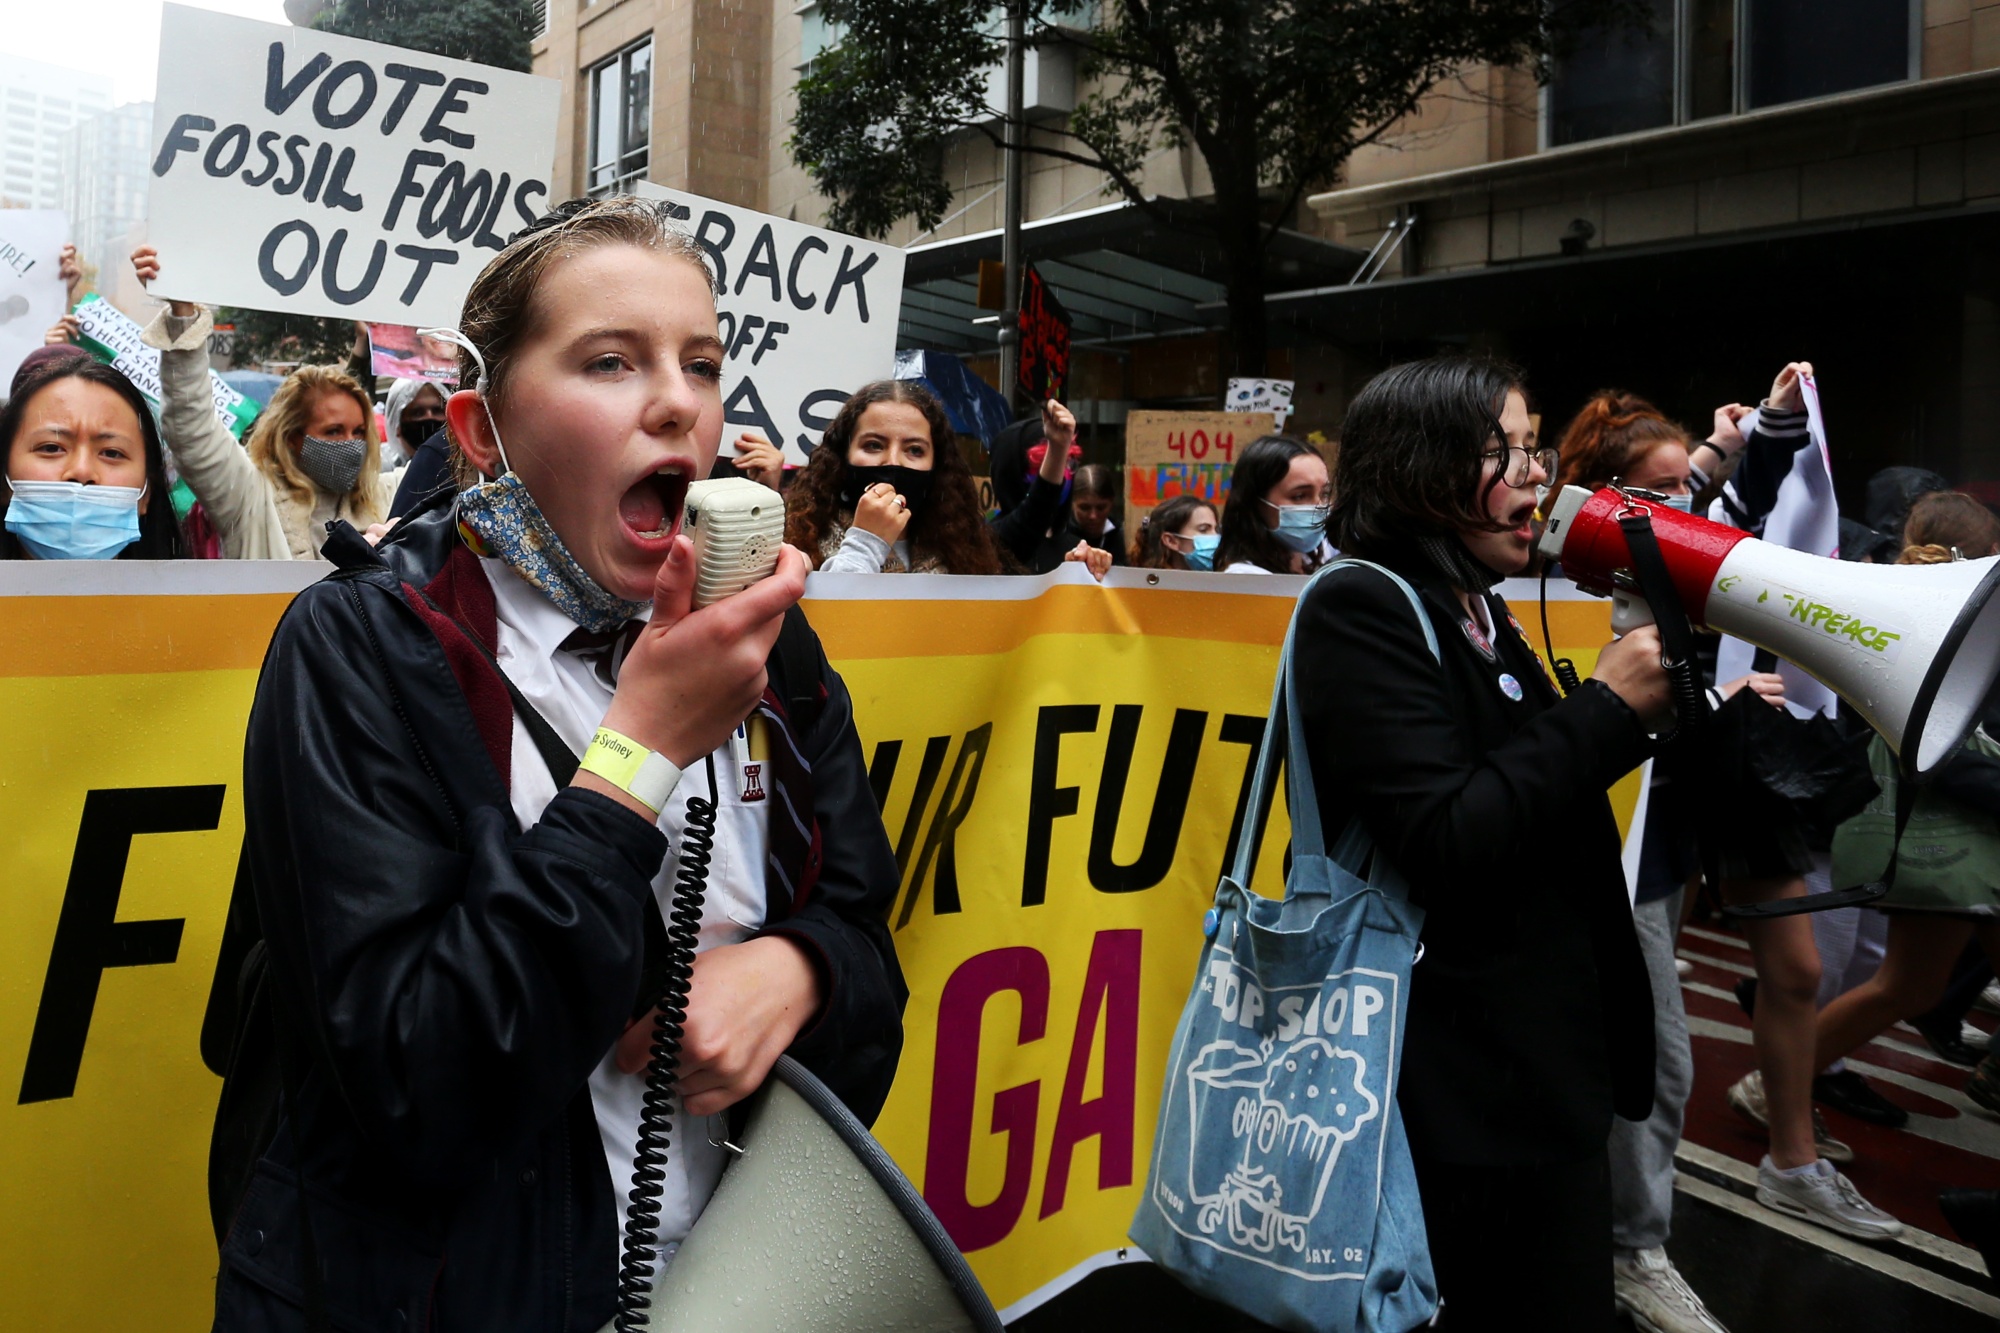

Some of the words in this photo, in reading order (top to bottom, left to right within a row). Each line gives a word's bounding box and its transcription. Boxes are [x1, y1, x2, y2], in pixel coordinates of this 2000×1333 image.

[265, 41, 489, 149] VOTE
[152, 114, 363, 212] FOSSIL
[381, 149, 547, 252] FOOLS
[258, 219, 459, 306] OUT
[657, 201, 879, 323] RACK
[84, 304, 112, 324] SAY
[114, 326, 148, 351] THEY
[96, 328, 132, 354] HELP
[99, 300, 124, 321] THE
[1167, 429, 1234, 462] 404
[600, 734, 633, 759] Sydney
[1021, 703, 1291, 908] FUT
[1210, 960, 1265, 1029] TOP
[924, 928, 1143, 1255] GA
